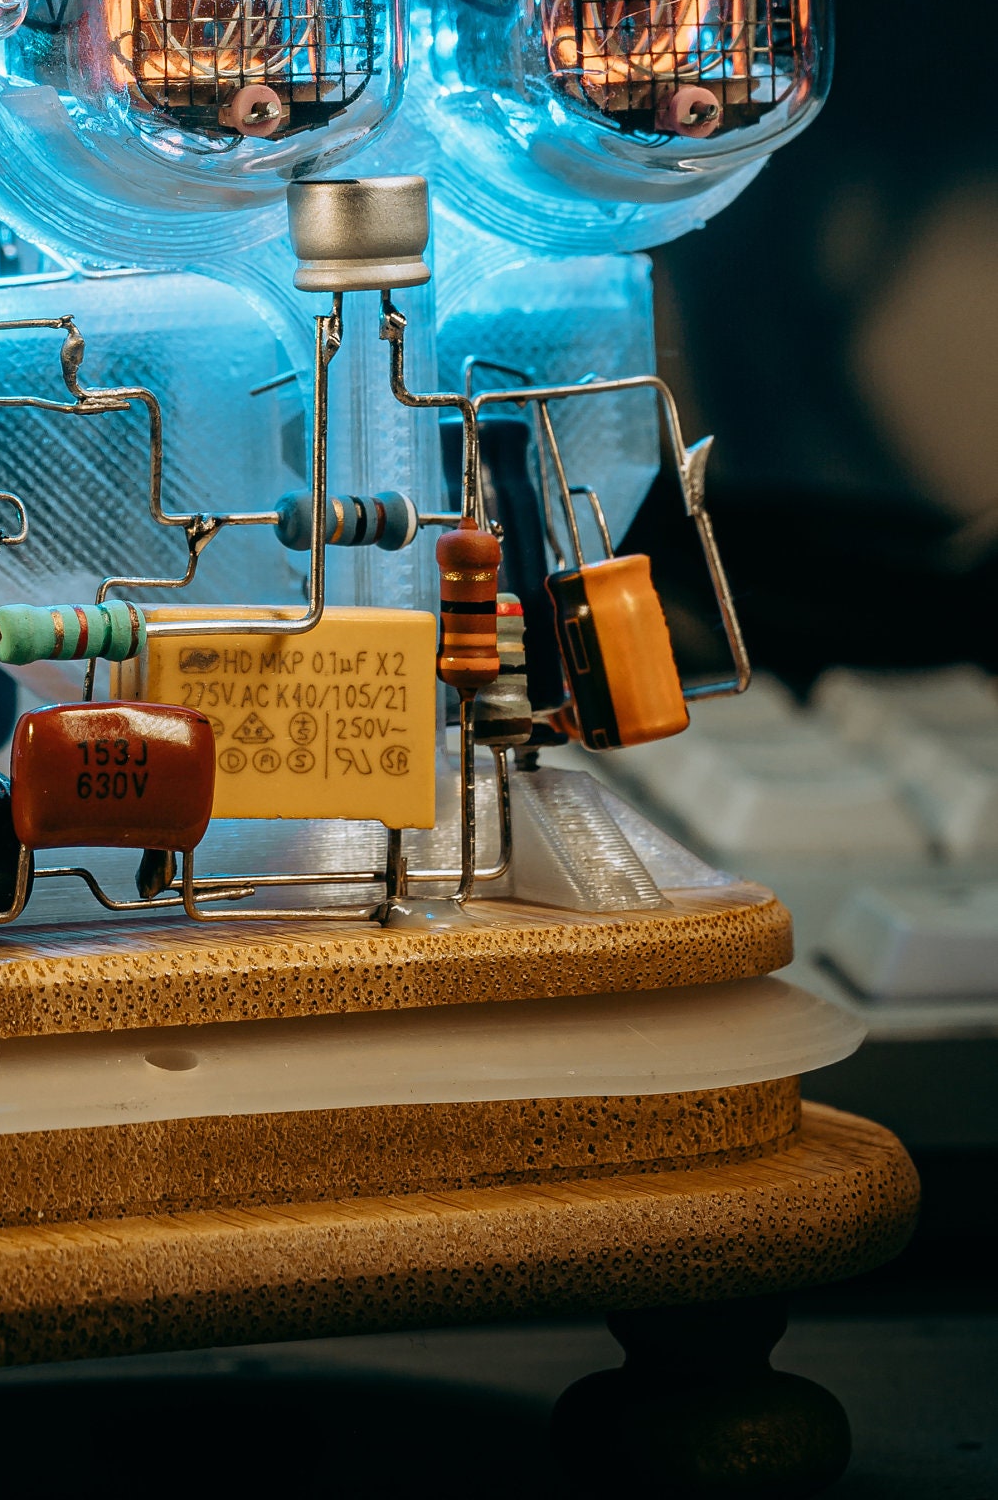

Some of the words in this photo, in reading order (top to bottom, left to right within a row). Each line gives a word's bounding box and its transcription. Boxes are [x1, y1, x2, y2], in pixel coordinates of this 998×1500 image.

[223, 649, 252, 674] HD
[259, 650, 304, 675] MKP
[77, 739, 149, 767] 153J
[76, 772, 149, 800] 630V
